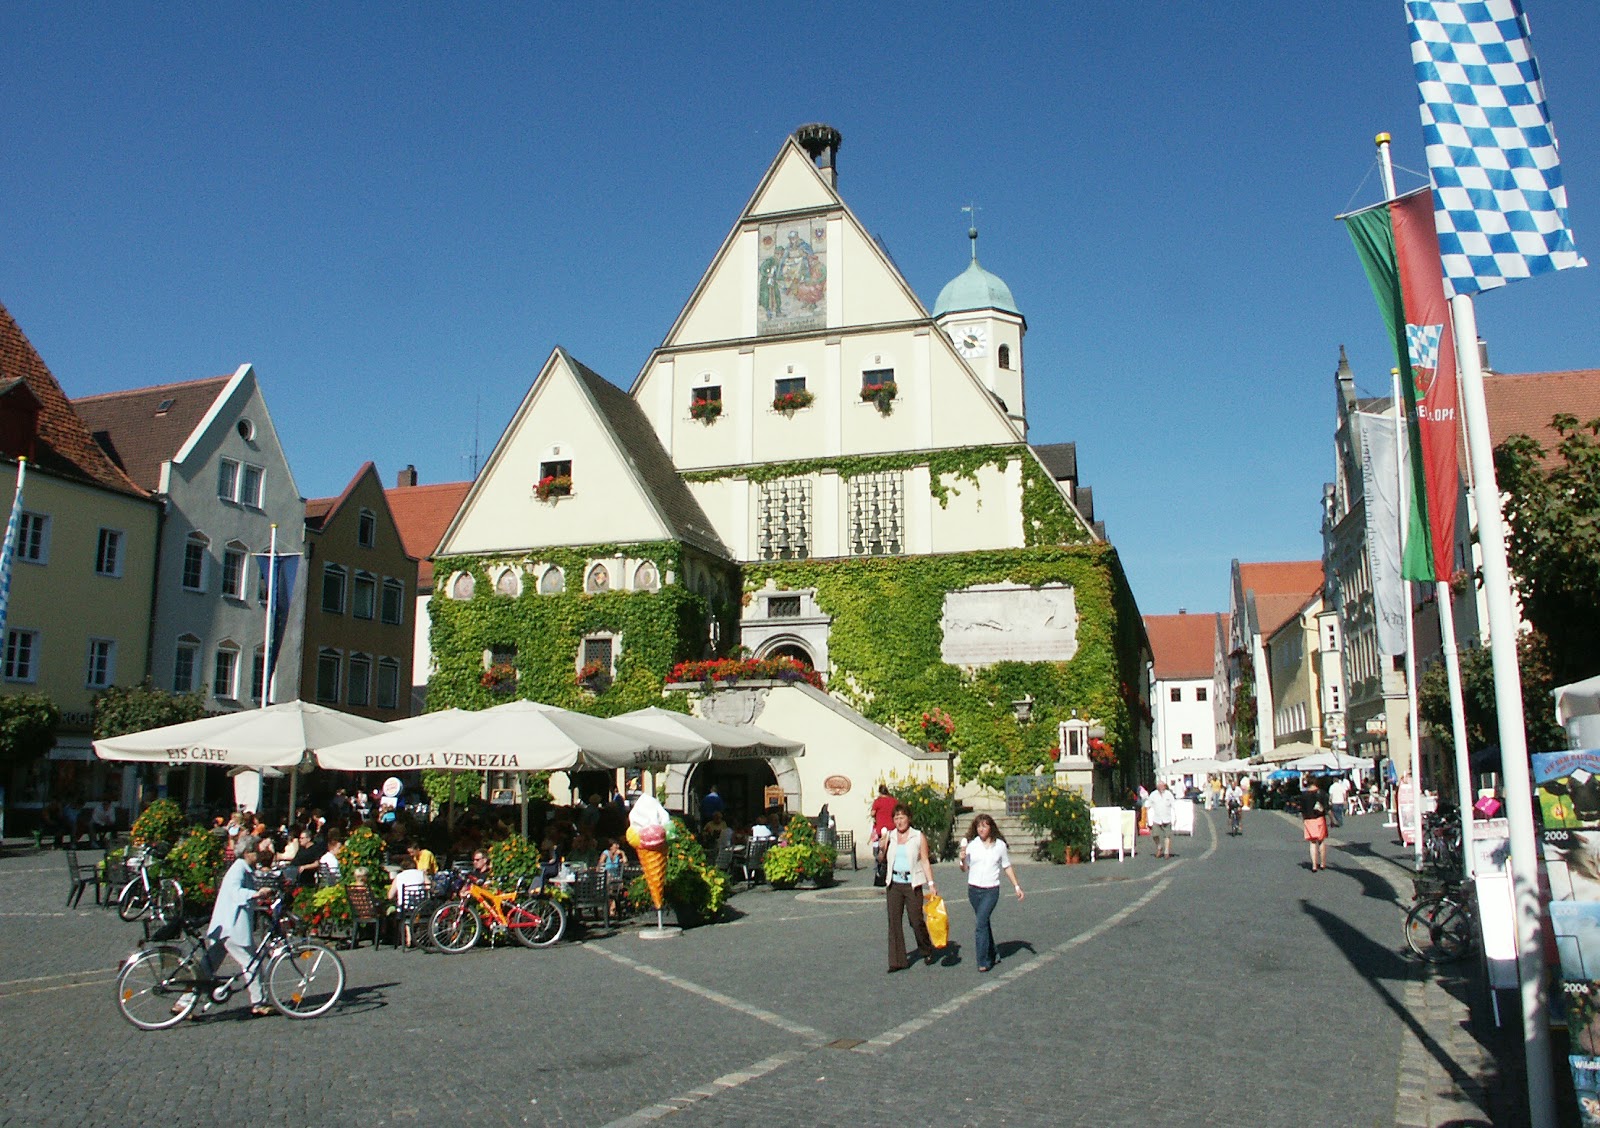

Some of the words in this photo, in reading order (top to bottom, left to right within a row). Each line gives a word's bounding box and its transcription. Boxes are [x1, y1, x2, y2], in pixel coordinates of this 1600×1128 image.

[166, 748, 187, 760] EIS
[365, 753, 436, 768] PICCOLA
[443, 752, 520, 767] VENEZIA
[633, 750, 647, 764] EIS
[1544, 830, 1569, 841] 2006
[1563, 982, 1589, 994] 2006
